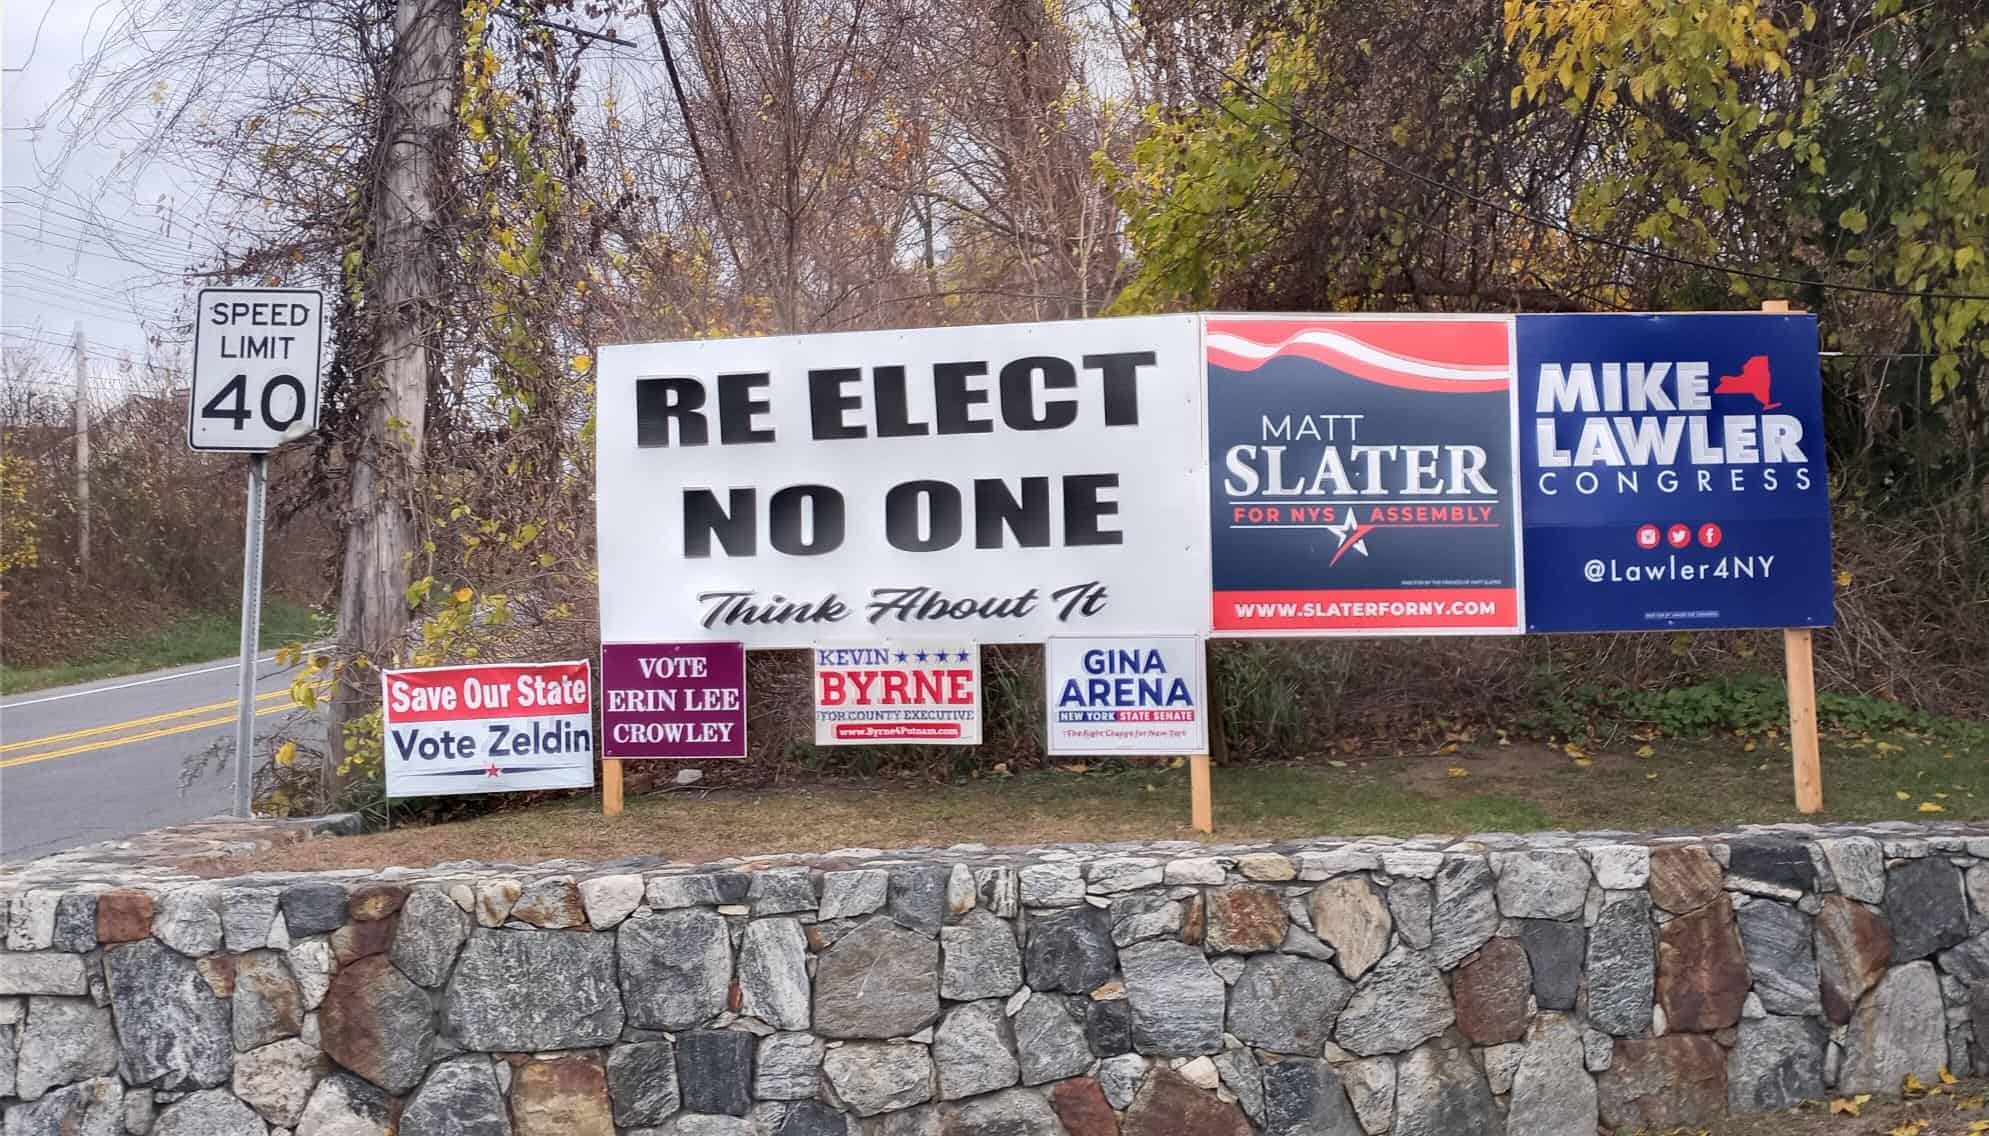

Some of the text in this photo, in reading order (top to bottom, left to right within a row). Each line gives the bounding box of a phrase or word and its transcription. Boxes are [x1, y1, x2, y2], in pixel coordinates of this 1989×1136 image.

[211, 302, 309, 326] SPEED
[220, 335, 295, 359] LIMIT
[636, 351, 1157, 448] RE ELECT
[1536, 361, 1712, 413] MIKE
[201, 374, 306, 432] 40
[1262, 415, 1364, 441] MATT
[1536, 414, 1809, 467] LAWLER
[1224, 444, 1498, 496] SLATER
[1539, 468, 1811, 495] CONGRESS
[682, 472, 1123, 559] NO ONE
[1234, 506, 1492, 522] FOR NYS ASSEMBLY
[1584, 555, 1775, 582] @Lawler4NY
[696, 580, 1107, 629] Think About It
[1234, 602, 1496, 618] WWW.SLATERFORNY.COM
[638, 657, 707, 679] VOTE
[819, 649, 889, 665] KEVIN
[1084, 649, 1168, 674] GINA
[391, 674, 587, 713] Save Our State
[607, 688, 740, 712] ERIN LEE
[819, 669, 974, 706] BYRNE
[1058, 677, 1194, 707] ARENA
[820, 709, 974, 722] FOR COUNTY EXECUTIVE
[1060, 710, 1193, 721] NEW YORK STATE SENATE
[391, 720, 591, 761] Vote Zeldin
[613, 722, 735, 743] CROWLEY
